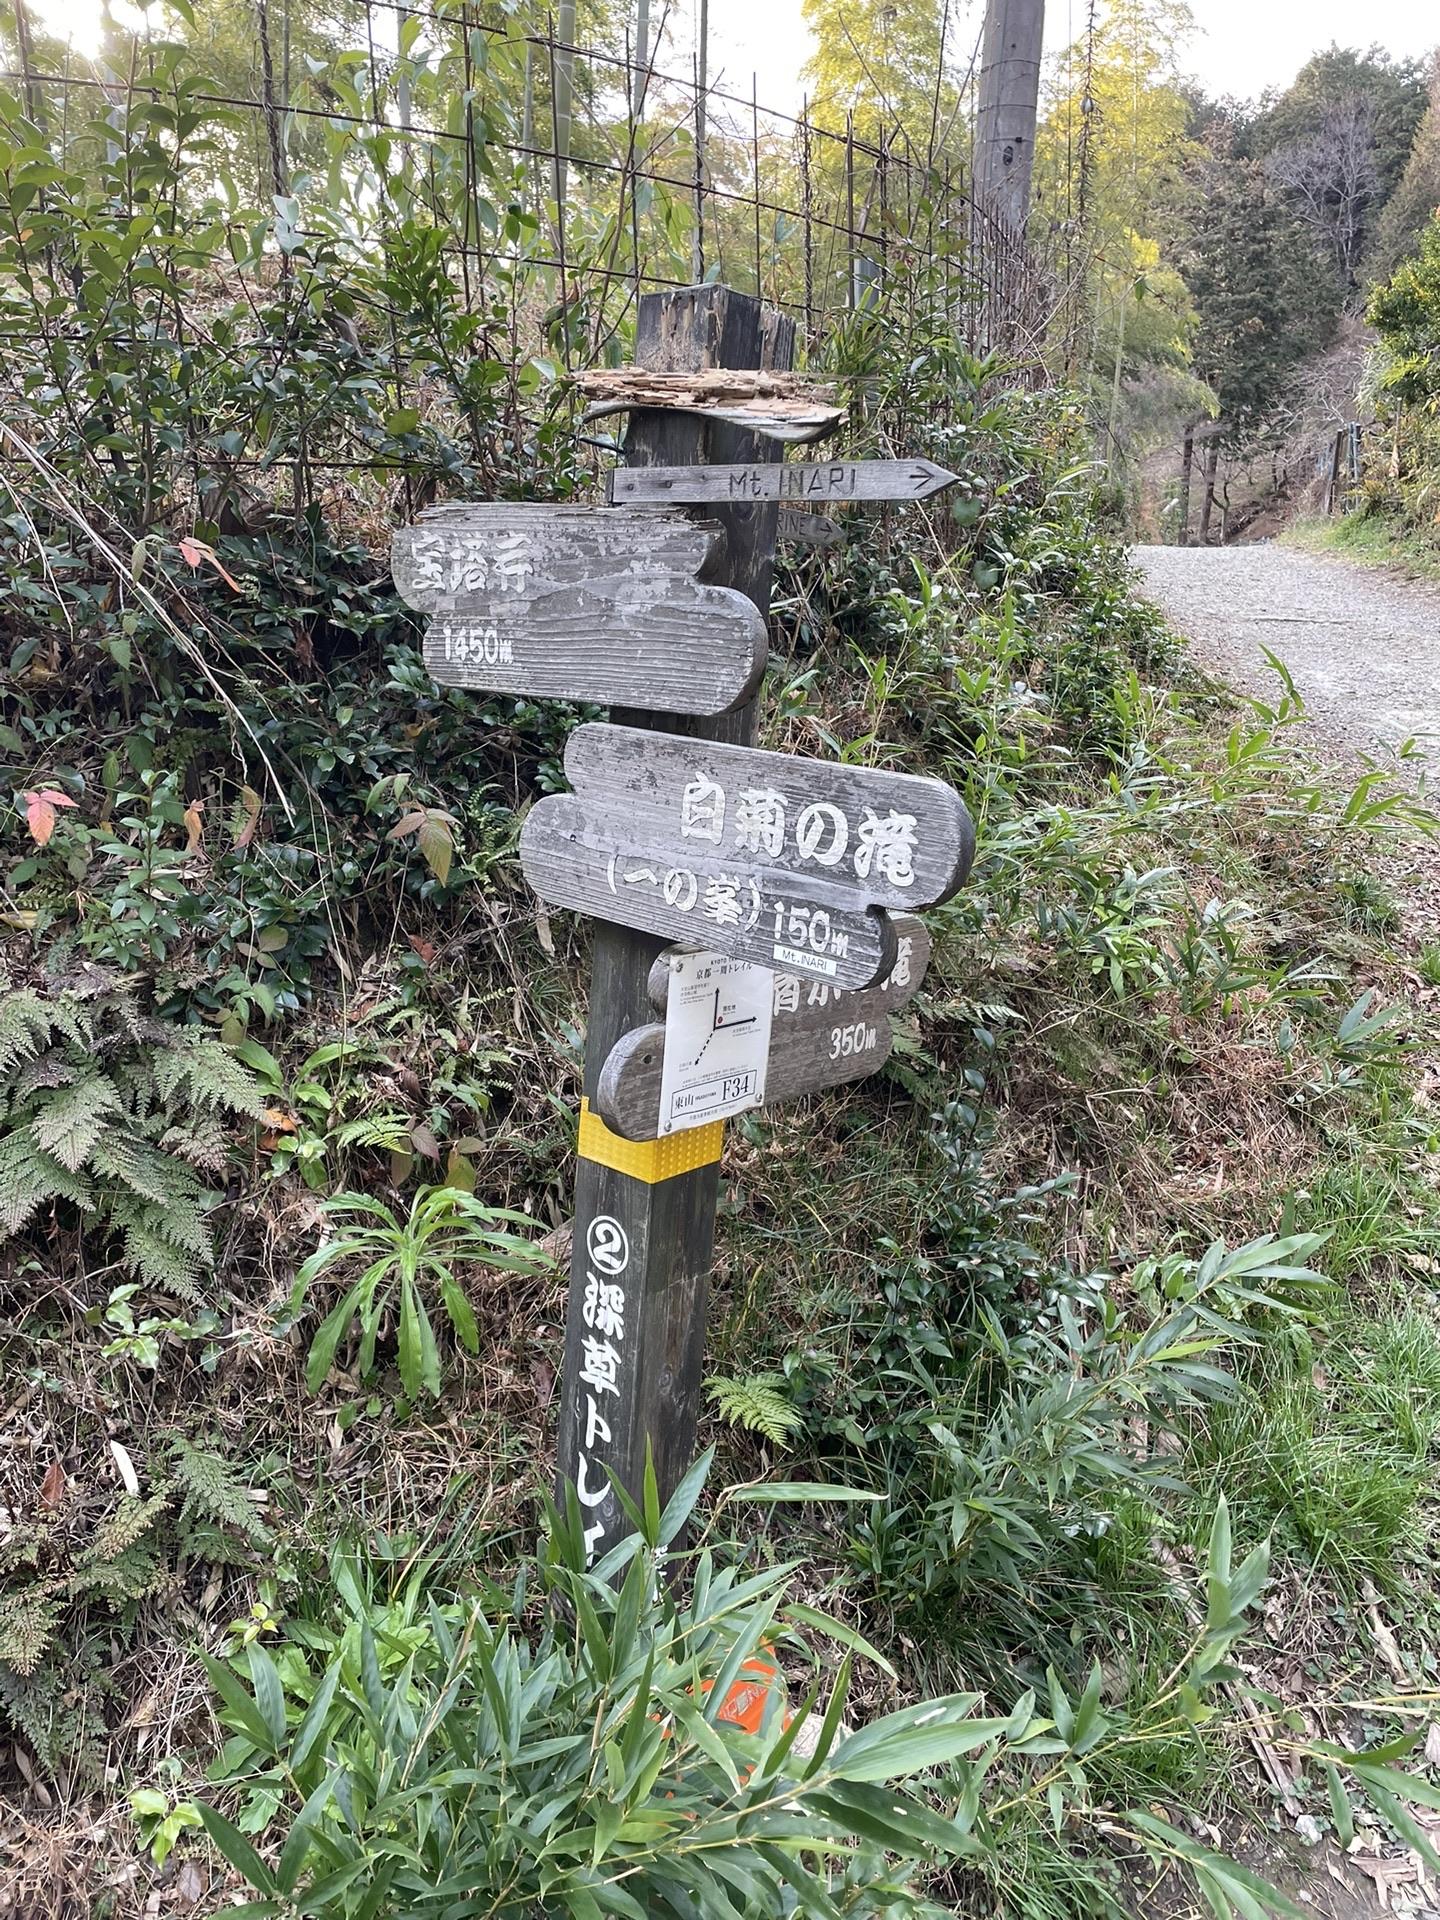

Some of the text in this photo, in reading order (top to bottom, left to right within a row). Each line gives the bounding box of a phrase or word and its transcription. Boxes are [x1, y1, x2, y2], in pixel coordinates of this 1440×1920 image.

[728, 466, 856, 497] Mt. INARI
[442, 625, 515, 665] 1450m
[680, 771, 919, 888] 白菊の滝
[773, 900, 849, 960] 150m
[829, 1022, 877, 1060] 350m
[722, 1075, 749, 1102] F34
